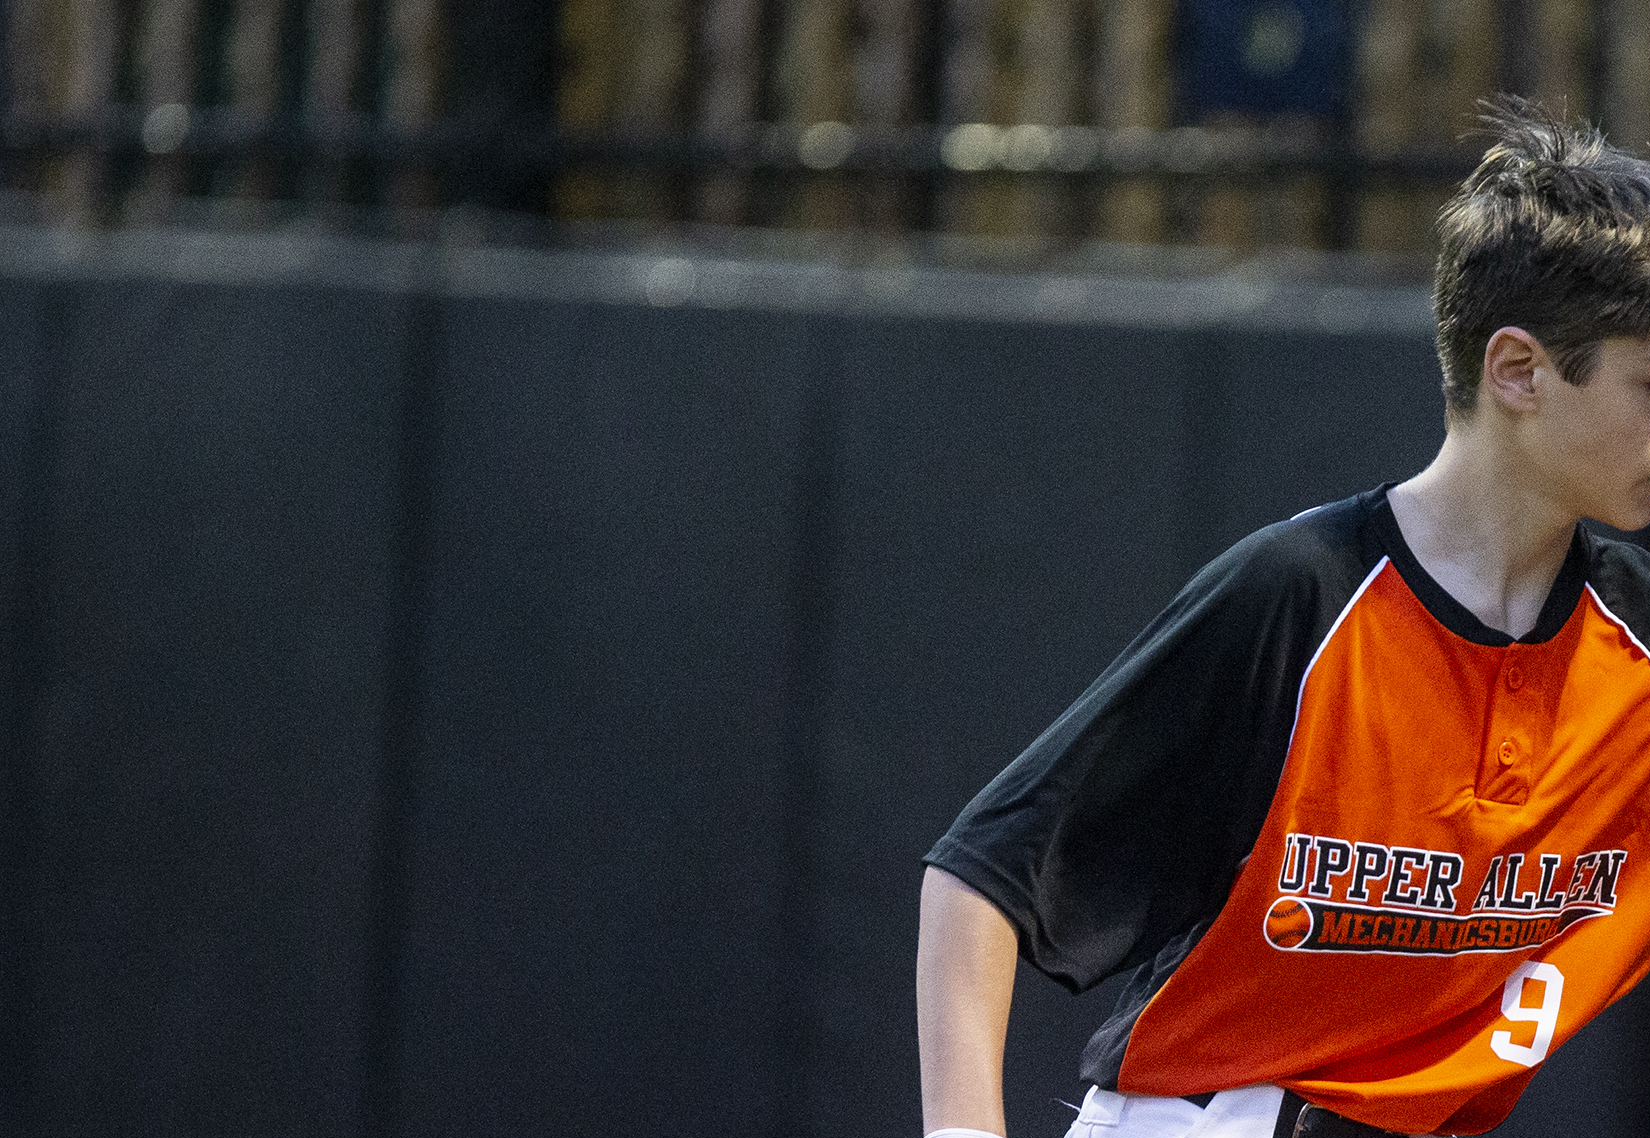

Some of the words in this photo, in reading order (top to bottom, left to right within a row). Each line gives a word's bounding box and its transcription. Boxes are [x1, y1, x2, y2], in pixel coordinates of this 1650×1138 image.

[1278, 833, 1464, 912] UPPER
[1471, 850, 1628, 912] ALLEN
[1490, 960, 1565, 1067] 9
